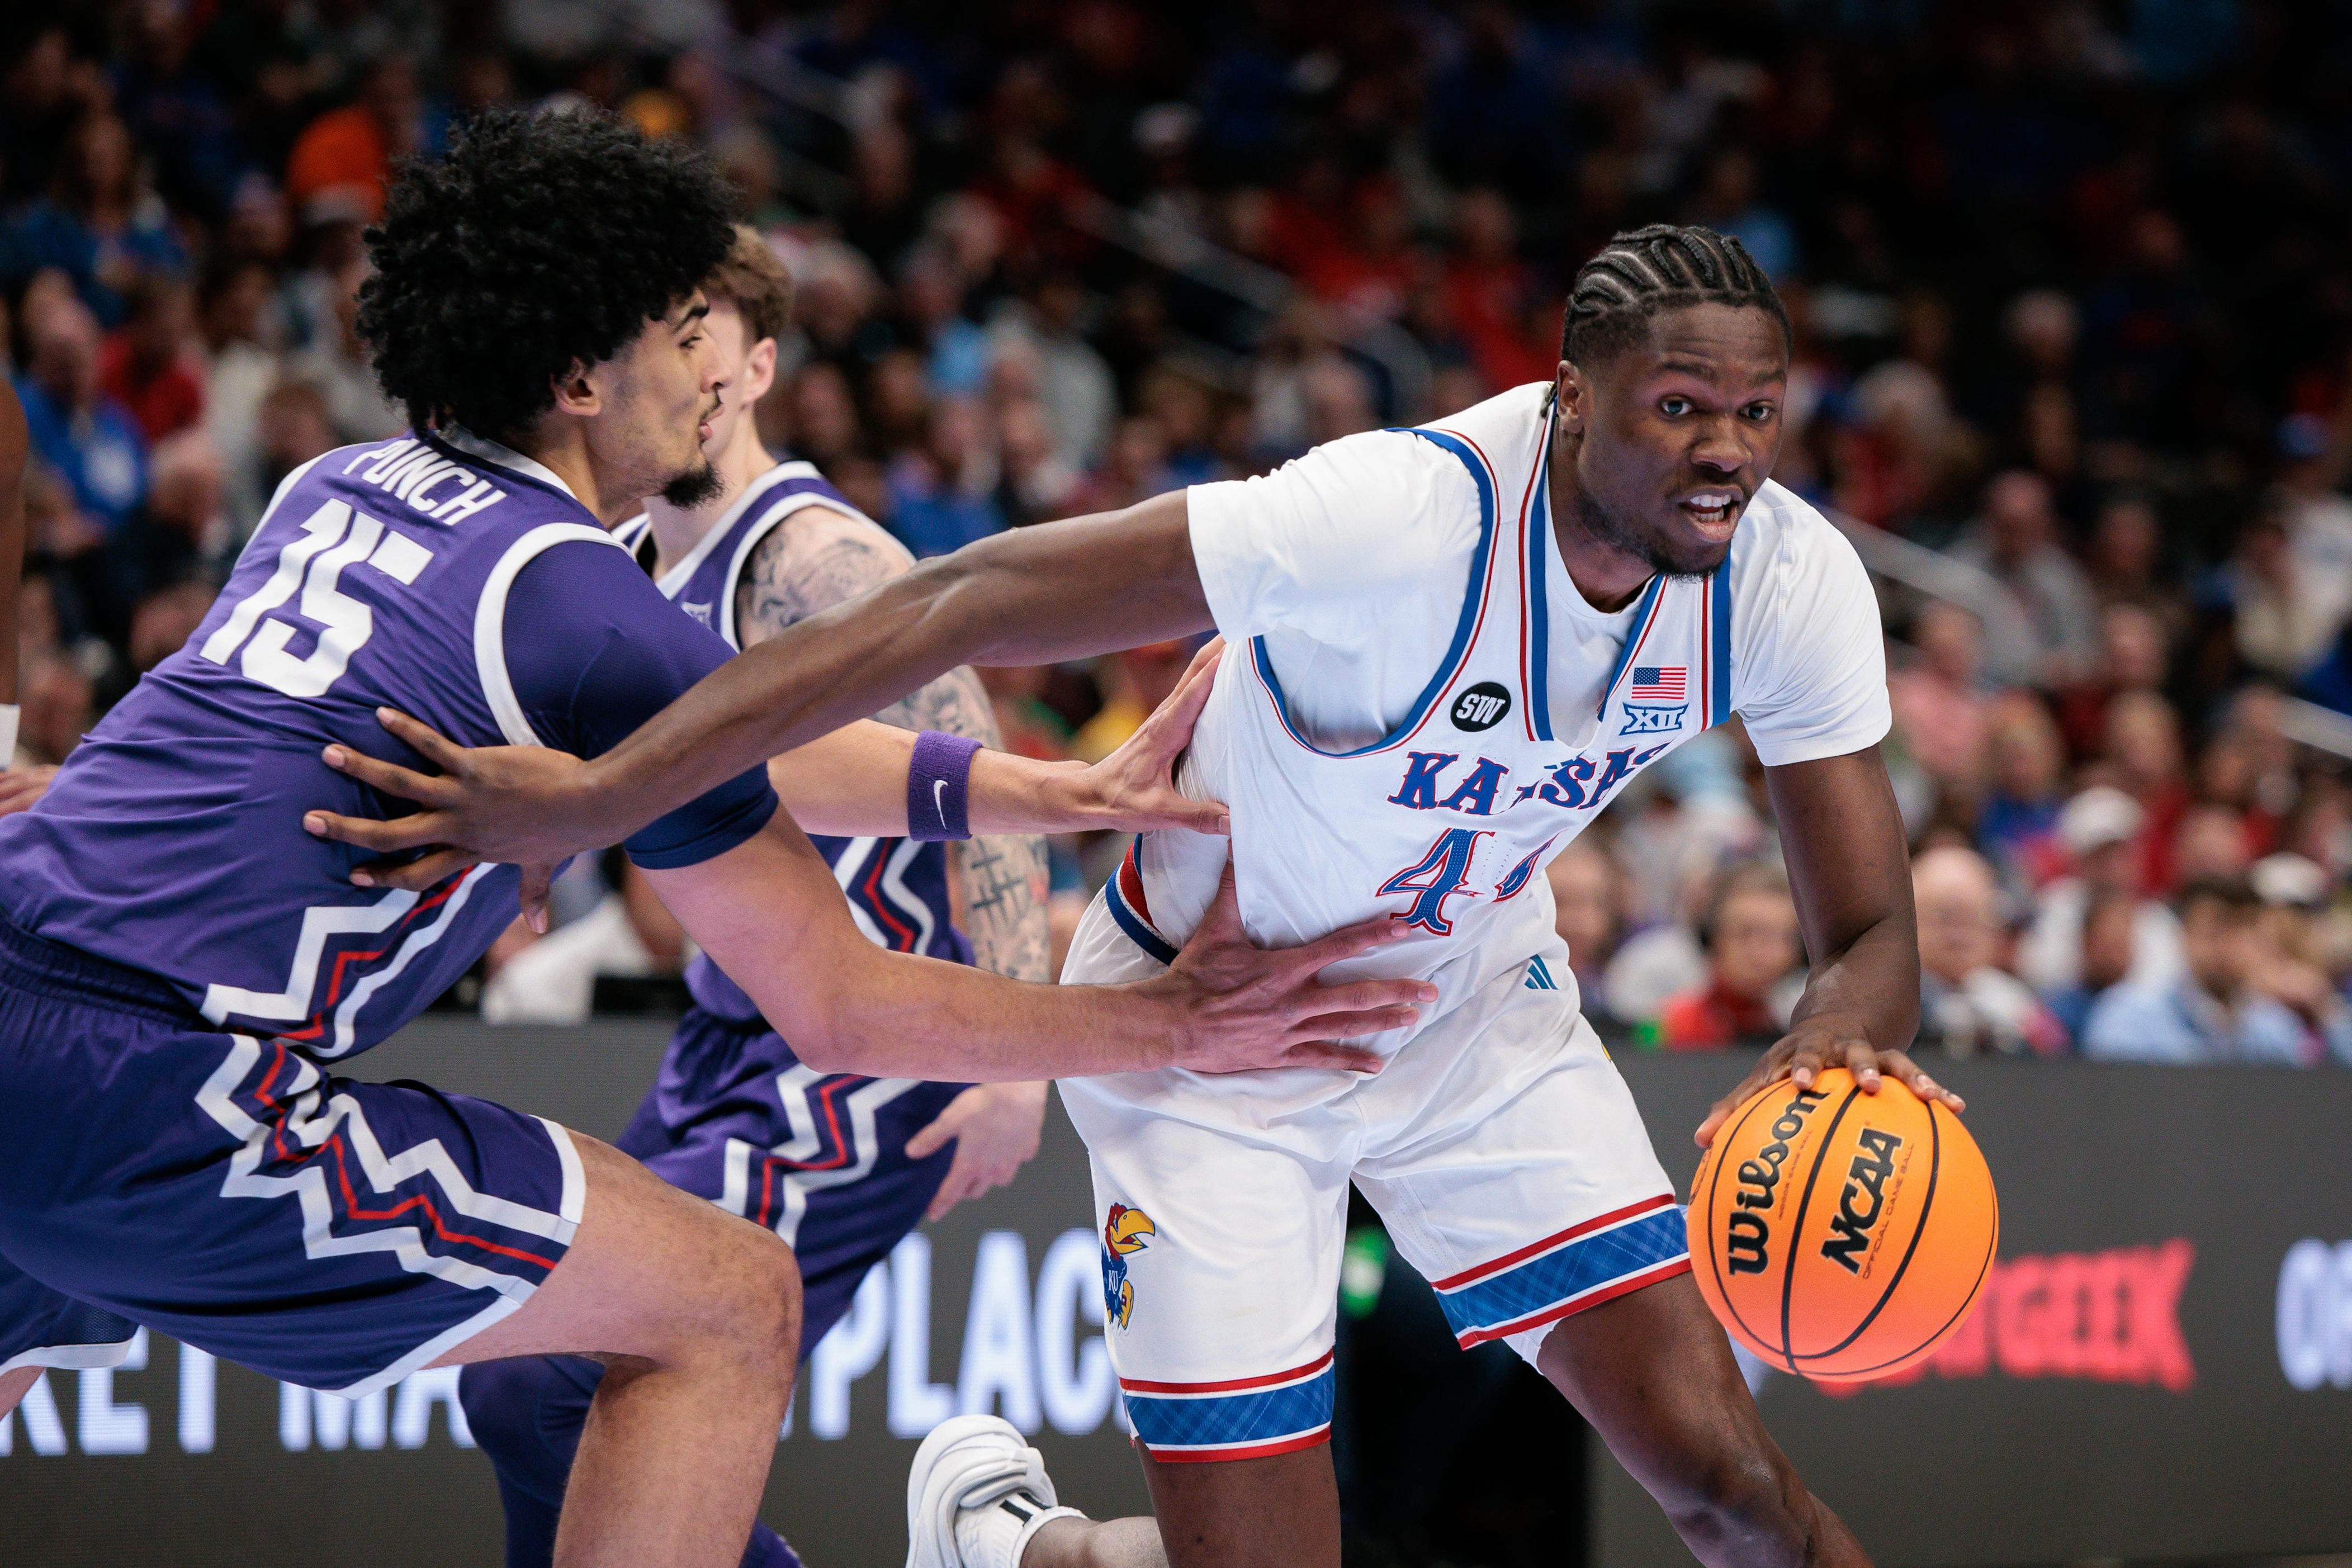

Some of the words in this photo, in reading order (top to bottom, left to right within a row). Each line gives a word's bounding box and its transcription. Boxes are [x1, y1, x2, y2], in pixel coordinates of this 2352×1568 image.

[342, 438, 508, 526] PUNCH
[199, 498, 434, 698] 15
[1728, 1089, 1830, 1276] Wilson
[1820, 1128, 1903, 1276] NCAA
[1862, 1219, 1890, 1280] OFFICIAL
[1886, 1177, 1904, 1216] GAME
[1108, 1269, 1119, 1295] KU
